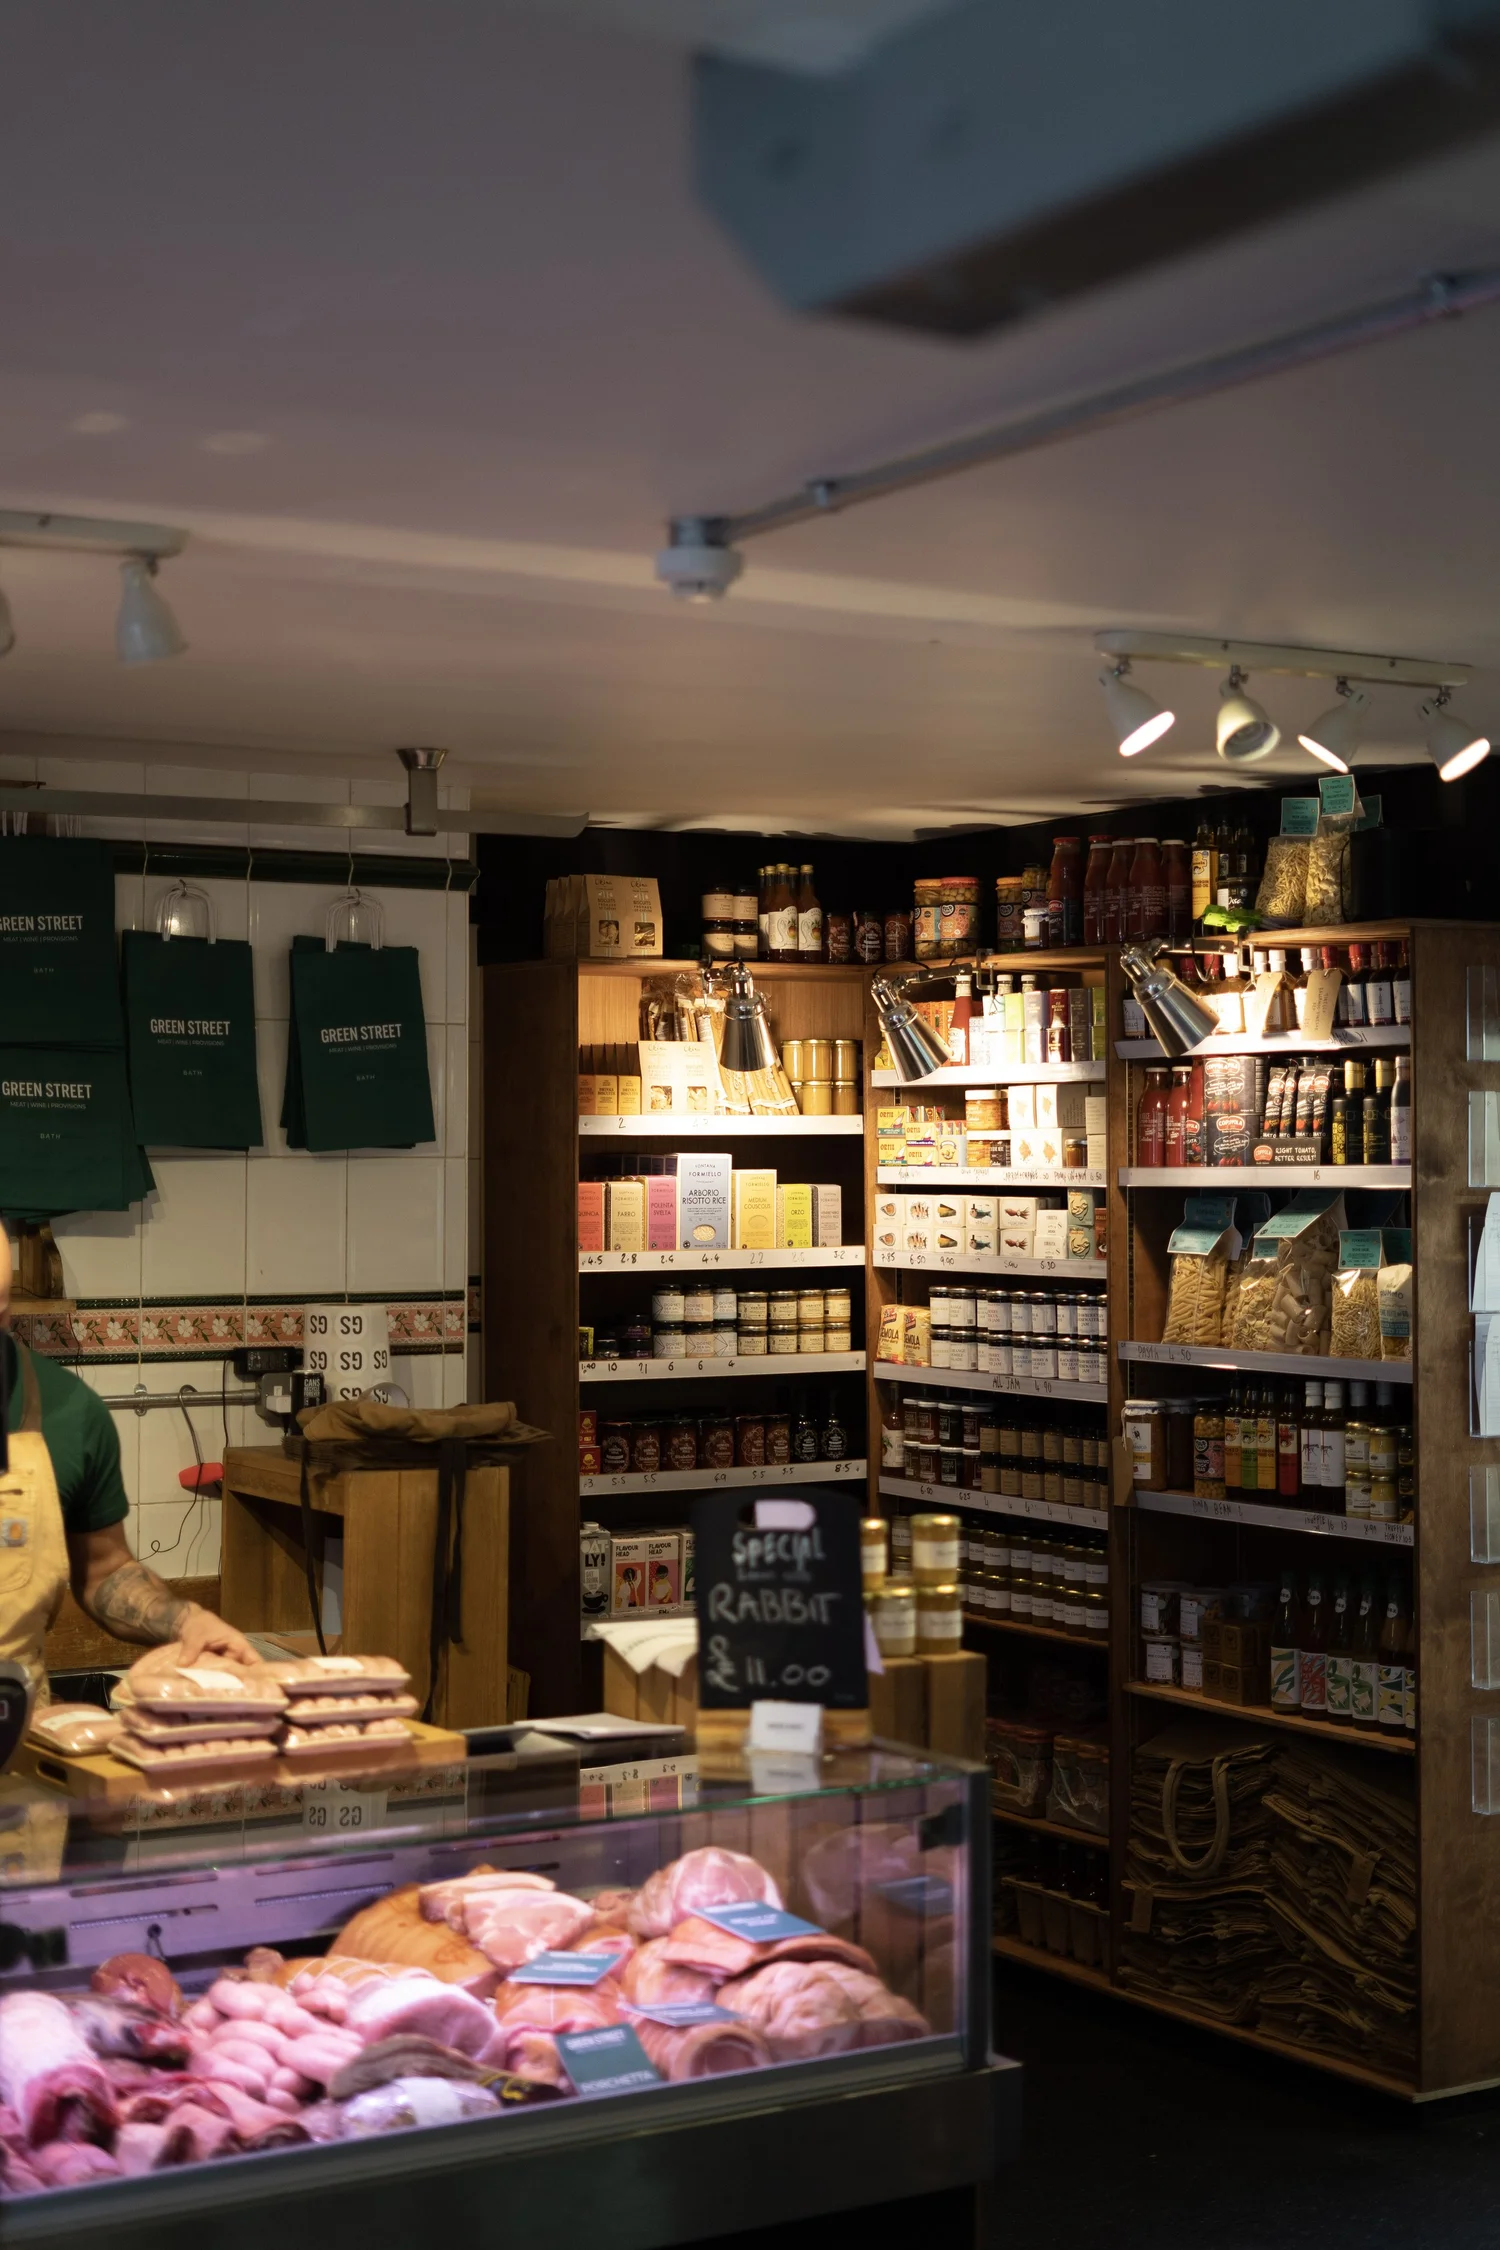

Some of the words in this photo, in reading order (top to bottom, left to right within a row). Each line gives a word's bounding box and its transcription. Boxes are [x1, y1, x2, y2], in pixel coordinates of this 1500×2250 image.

[37, 915, 84, 931] STREET
[150, 1018, 185, 1035] GREEN
[187, 1020, 231, 1036] STREET
[320, 1027, 358, 1043] GREEN
[360, 1023, 402, 1040] STREET
[2, 1081, 43, 1097] GREEN
[45, 1083, 92, 1099] STREET
[1275, 1146, 1292, 1154] RIGHT
[1295, 1146, 1317, 1155] TOMATO,
[688, 1189, 720, 1197] ARBORIO
[682, 1197, 711, 1205] RISOTTO
[712, 1197, 727, 1205] RICE
[620, 1252, 638, 1264] 2.8
[701, 1252, 720, 1264] 4.4
[750, 1251, 764, 1265] 2.2
[340, 1315, 363, 1335] GS
[340, 1351, 363, 1371] GS
[607, 1362, 618, 1372] 10
[667, 1361, 674, 1371] 6
[697, 1360, 704, 1370] 6
[304, 1379, 321, 1387] CANS
[1006, 1376, 1021, 1391] JAM
[834, 1463, 851, 1473] 8.5
[1213, 1502, 1232, 1516] BEAN
[1384, 1522, 1405, 1534] TRUFFLE
[1384, 1532, 1402, 1543] HONEY
[615, 1544, 639, 1552] FLAVOUR
[648, 1542, 672, 1550] FLAVOUR
[585, 1553, 606, 1568] LY!
[707, 1582, 842, 1625] RABBIT
